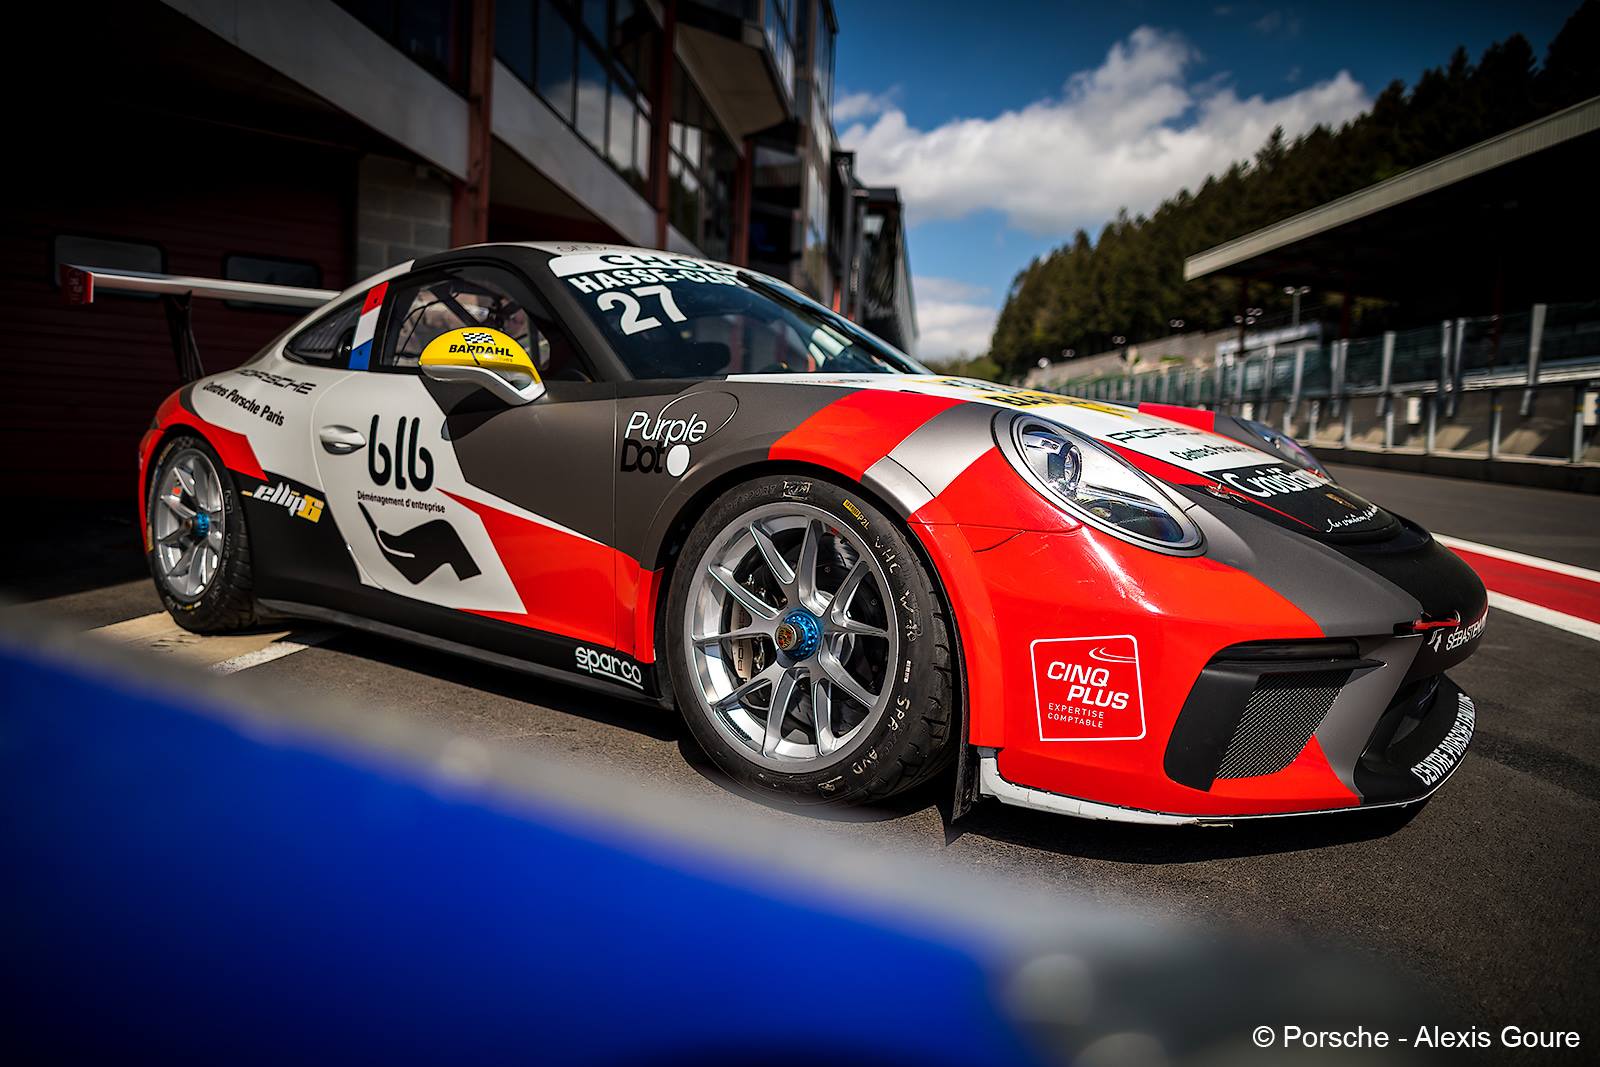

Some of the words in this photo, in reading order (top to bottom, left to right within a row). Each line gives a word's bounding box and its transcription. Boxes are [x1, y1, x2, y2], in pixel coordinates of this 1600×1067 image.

[597, 284, 687, 336] 27
[450, 344, 514, 358] BARDAHL
[226, 389, 261, 415] Porsche
[260, 405, 285, 427] Paris
[624, 410, 708, 448] Purple
[575, 646, 643, 684] sparco
[1047, 660, 1110, 687] CINQ
[1048, 702, 1105, 719] EXPERTISE
[1066, 684, 1130, 710] PLUS
[1047, 712, 1103, 729] COMPTABLE
[1411, 748, 1455, 786] CENTRE
